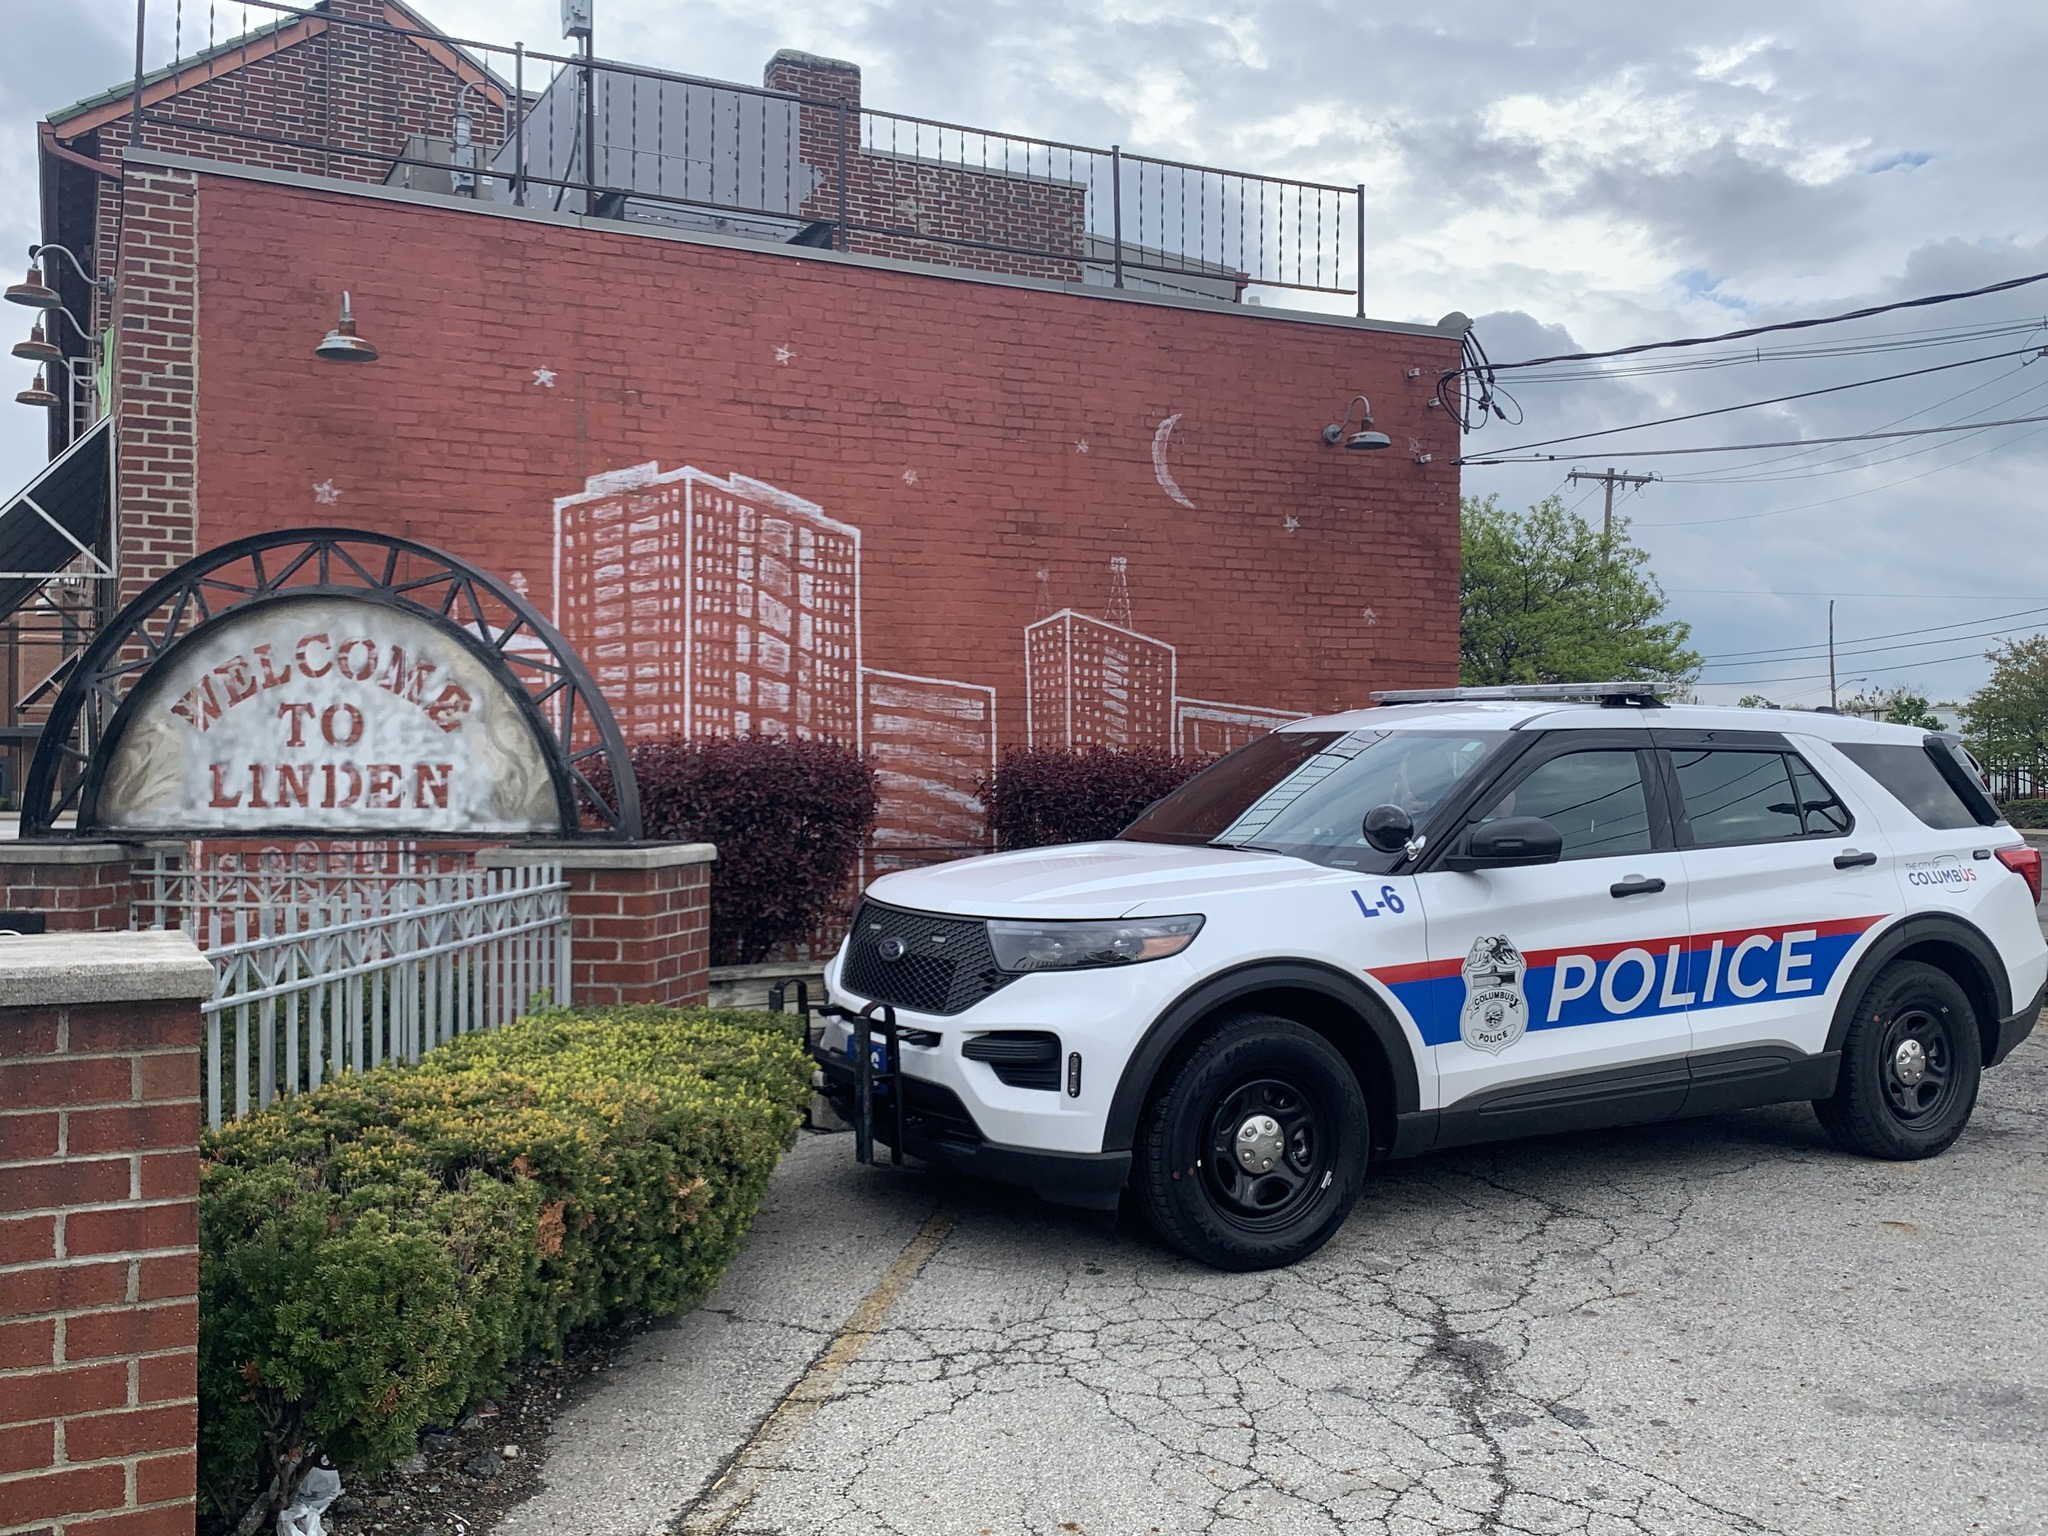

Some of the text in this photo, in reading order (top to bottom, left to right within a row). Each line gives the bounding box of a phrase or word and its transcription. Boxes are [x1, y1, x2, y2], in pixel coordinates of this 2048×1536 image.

[171, 633, 473, 733] WELCOME
[278, 702, 364, 747] TO
[208, 764, 453, 809] LINDEN
[1905, 862, 1918, 871] THE
[1919, 861, 1932, 870] CITY
[1908, 868, 1977, 886] COLUMBUS
[1350, 885, 1405, 918] L-6
[1546, 929, 1817, 1022] POLICE
[1474, 991, 1515, 1006] COLUMBUS
[1478, 1030, 1509, 1043] POLICE
